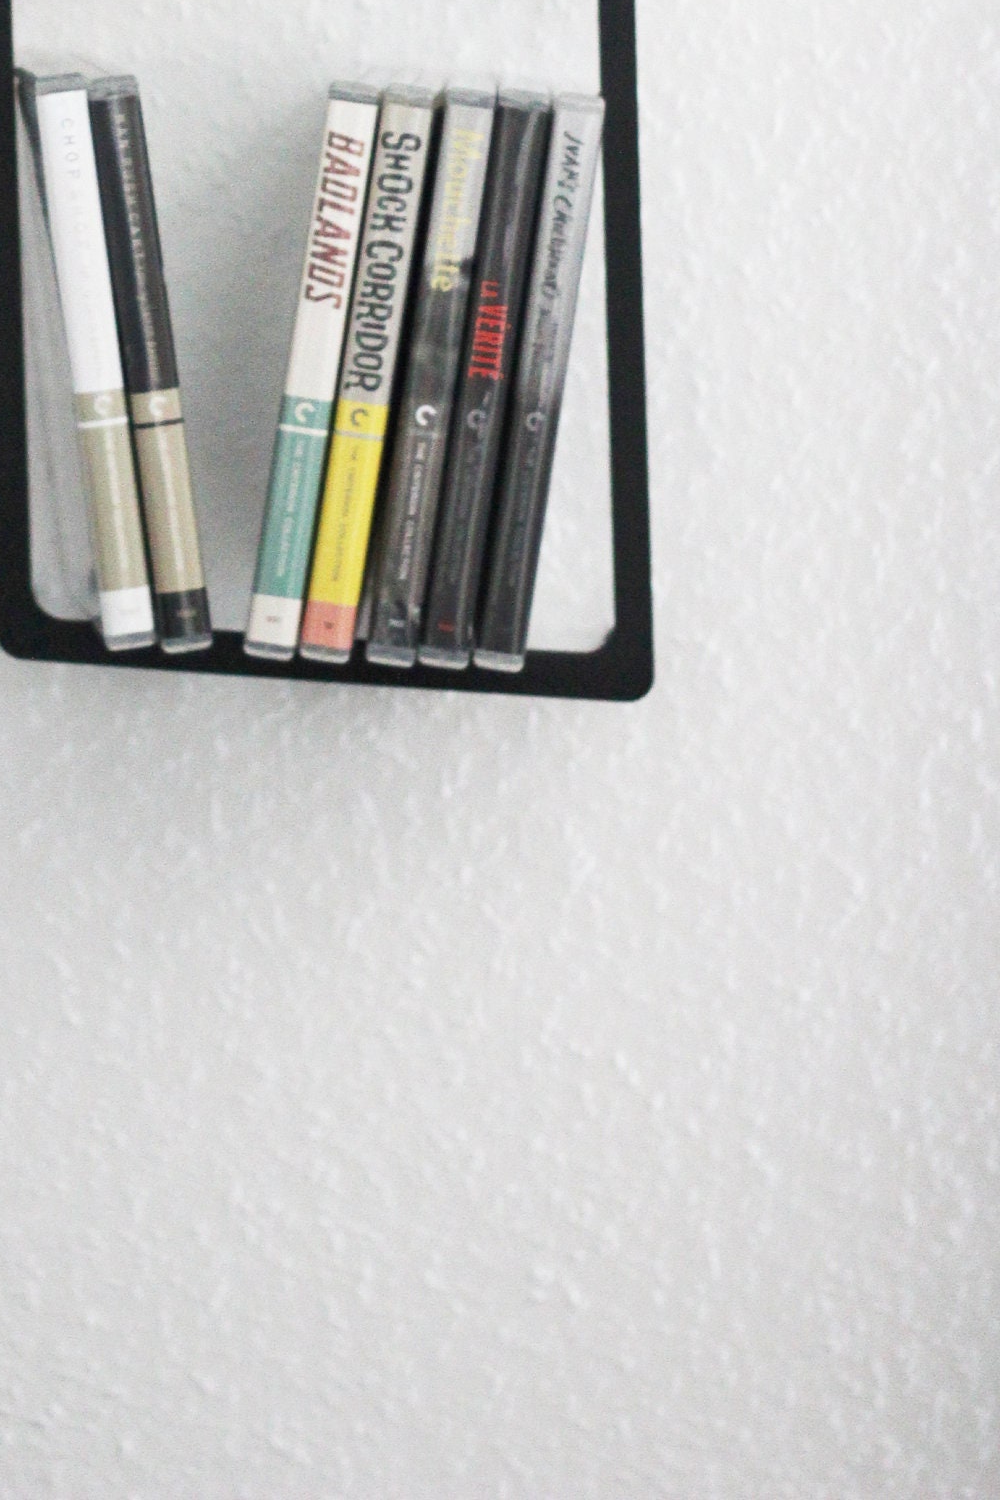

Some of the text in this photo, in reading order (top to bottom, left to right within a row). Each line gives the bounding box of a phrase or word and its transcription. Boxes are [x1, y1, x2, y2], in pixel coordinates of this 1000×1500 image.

[303, 130, 365, 310] BADLANDS
[368, 130, 422, 234] SHOCK
[343, 239, 404, 393] CORRIDOR
